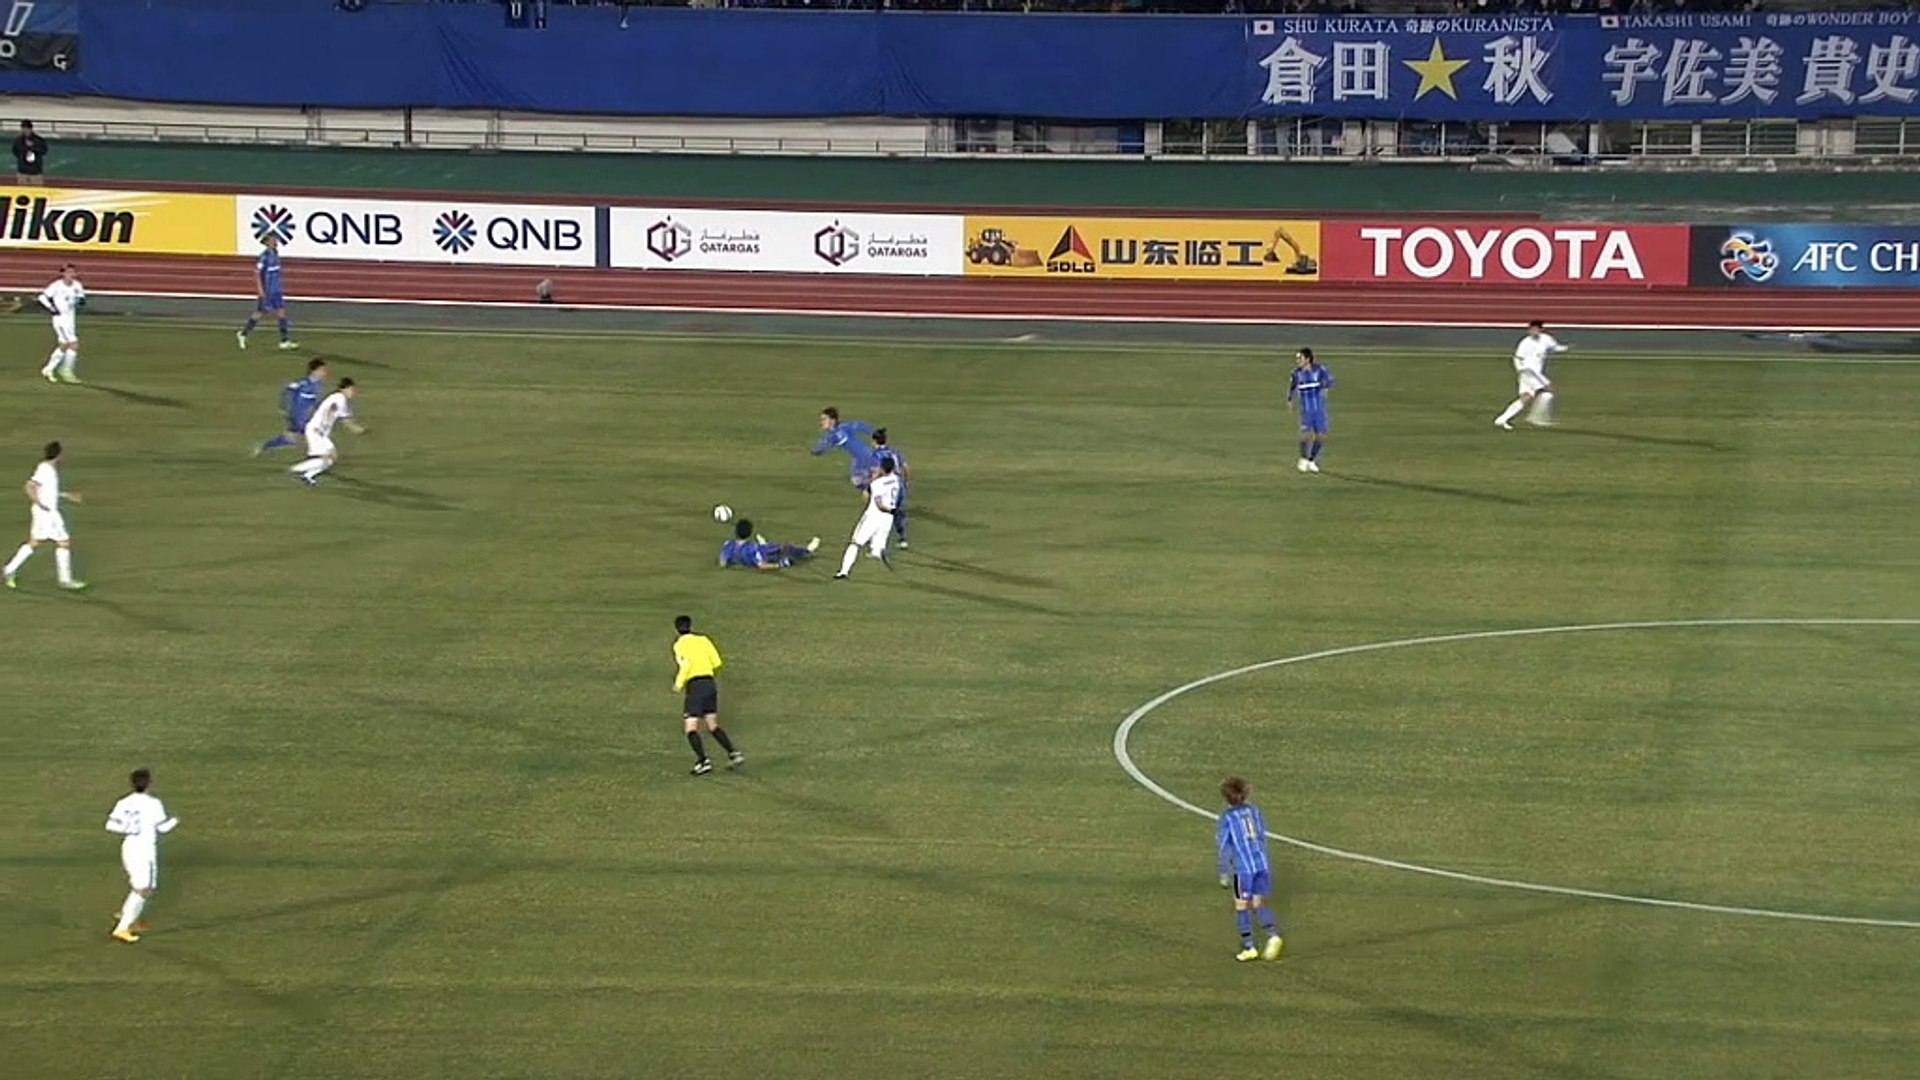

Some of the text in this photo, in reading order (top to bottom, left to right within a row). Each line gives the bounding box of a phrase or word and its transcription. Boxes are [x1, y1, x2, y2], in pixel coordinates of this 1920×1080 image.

[1284, 20, 1318, 33] SHU
[1325, 20, 1398, 33] KURATA
[1621, 15, 1693, 28] TAKASHI
[1700, 15, 1750, 27] USAMI
[306, 211, 402, 245] QNB
[486, 217, 582, 250] QNB
[700, 242, 760, 254] QATARGAS
[868, 246, 928, 258] QATARGAS
[1101, 238, 1264, 266] 山东临工
[1360, 227, 1645, 279] TOYOTA
[1792, 242, 1858, 272] AFC
[1046, 262, 1096, 273] SDLG
